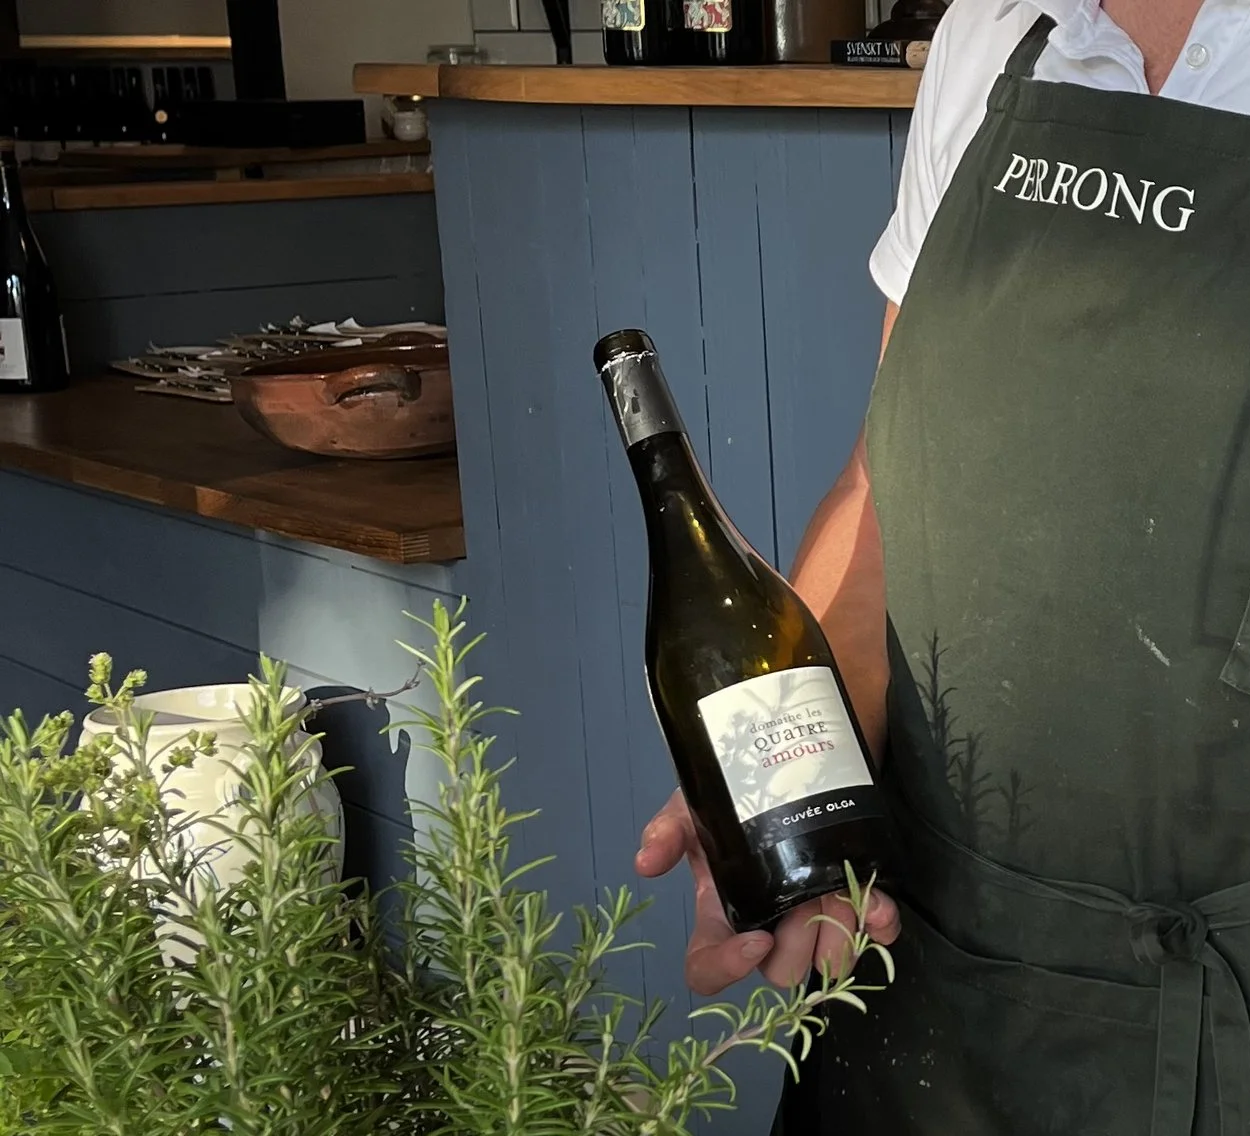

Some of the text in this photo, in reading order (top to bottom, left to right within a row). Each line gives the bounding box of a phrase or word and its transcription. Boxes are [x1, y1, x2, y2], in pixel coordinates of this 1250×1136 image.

[846, 41, 901, 56] SVENSKT VIN
[993, 153, 1196, 232] PERRONG
[807, 707, 823, 718] les
[762, 739, 835, 768] amours
[782, 799, 856, 826] CUVÉE OLGA
